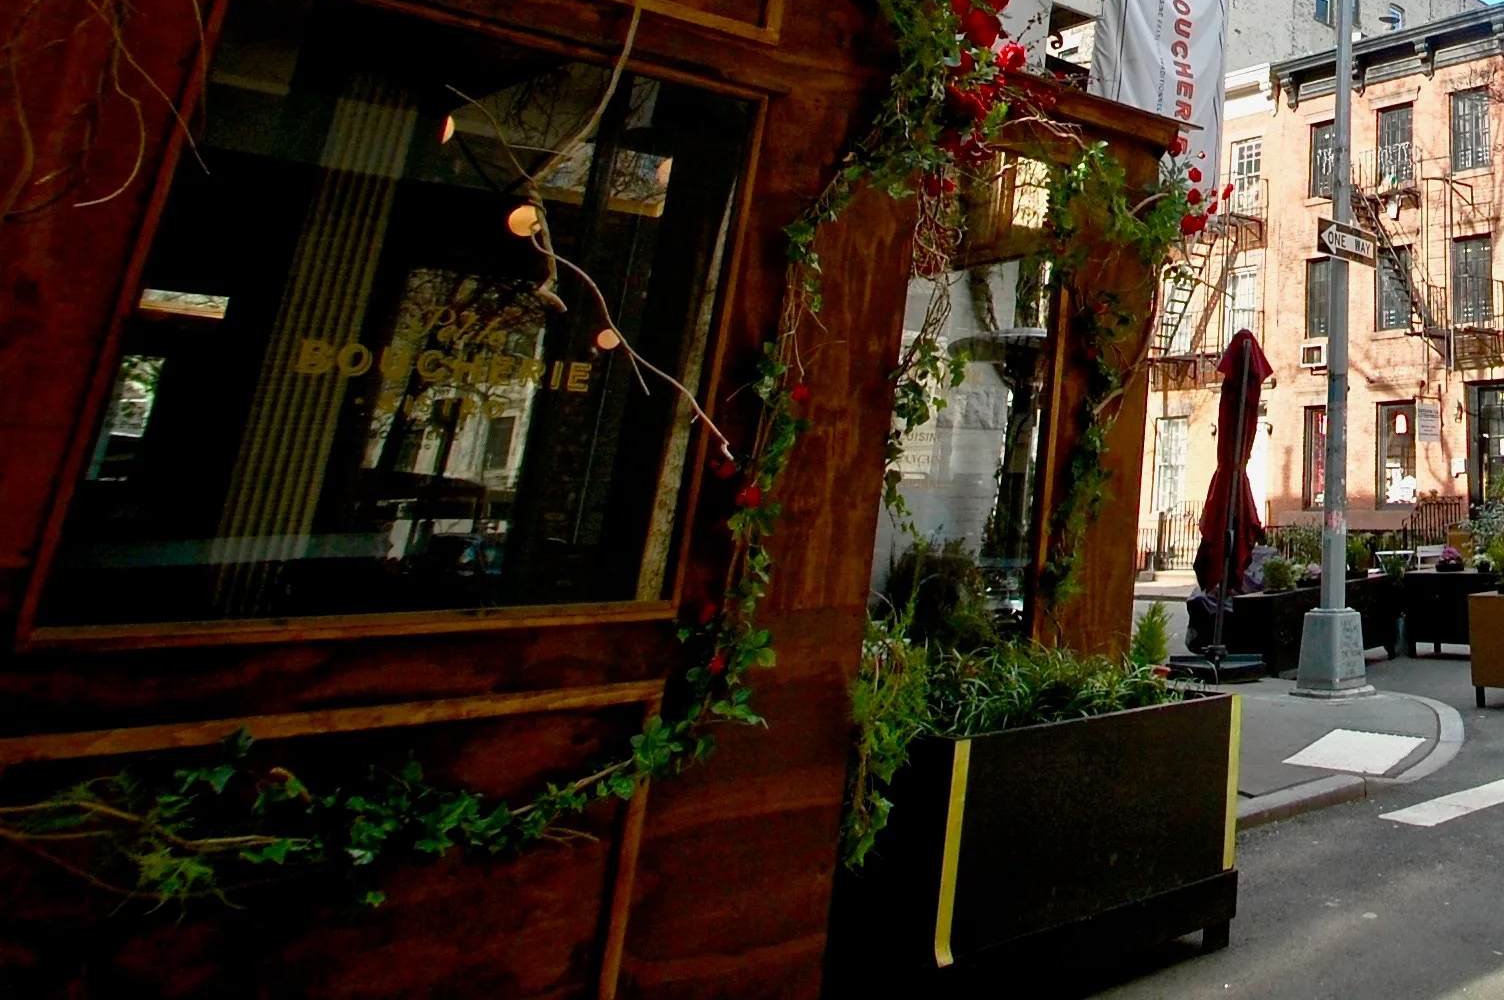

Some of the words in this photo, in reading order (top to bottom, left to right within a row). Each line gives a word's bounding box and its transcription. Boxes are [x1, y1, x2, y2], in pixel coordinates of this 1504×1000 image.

[1328, 231, 1346, 248] ONE
[1354, 238, 1371, 255] WAY
[294, 339, 593, 392] BOUCHERIE
